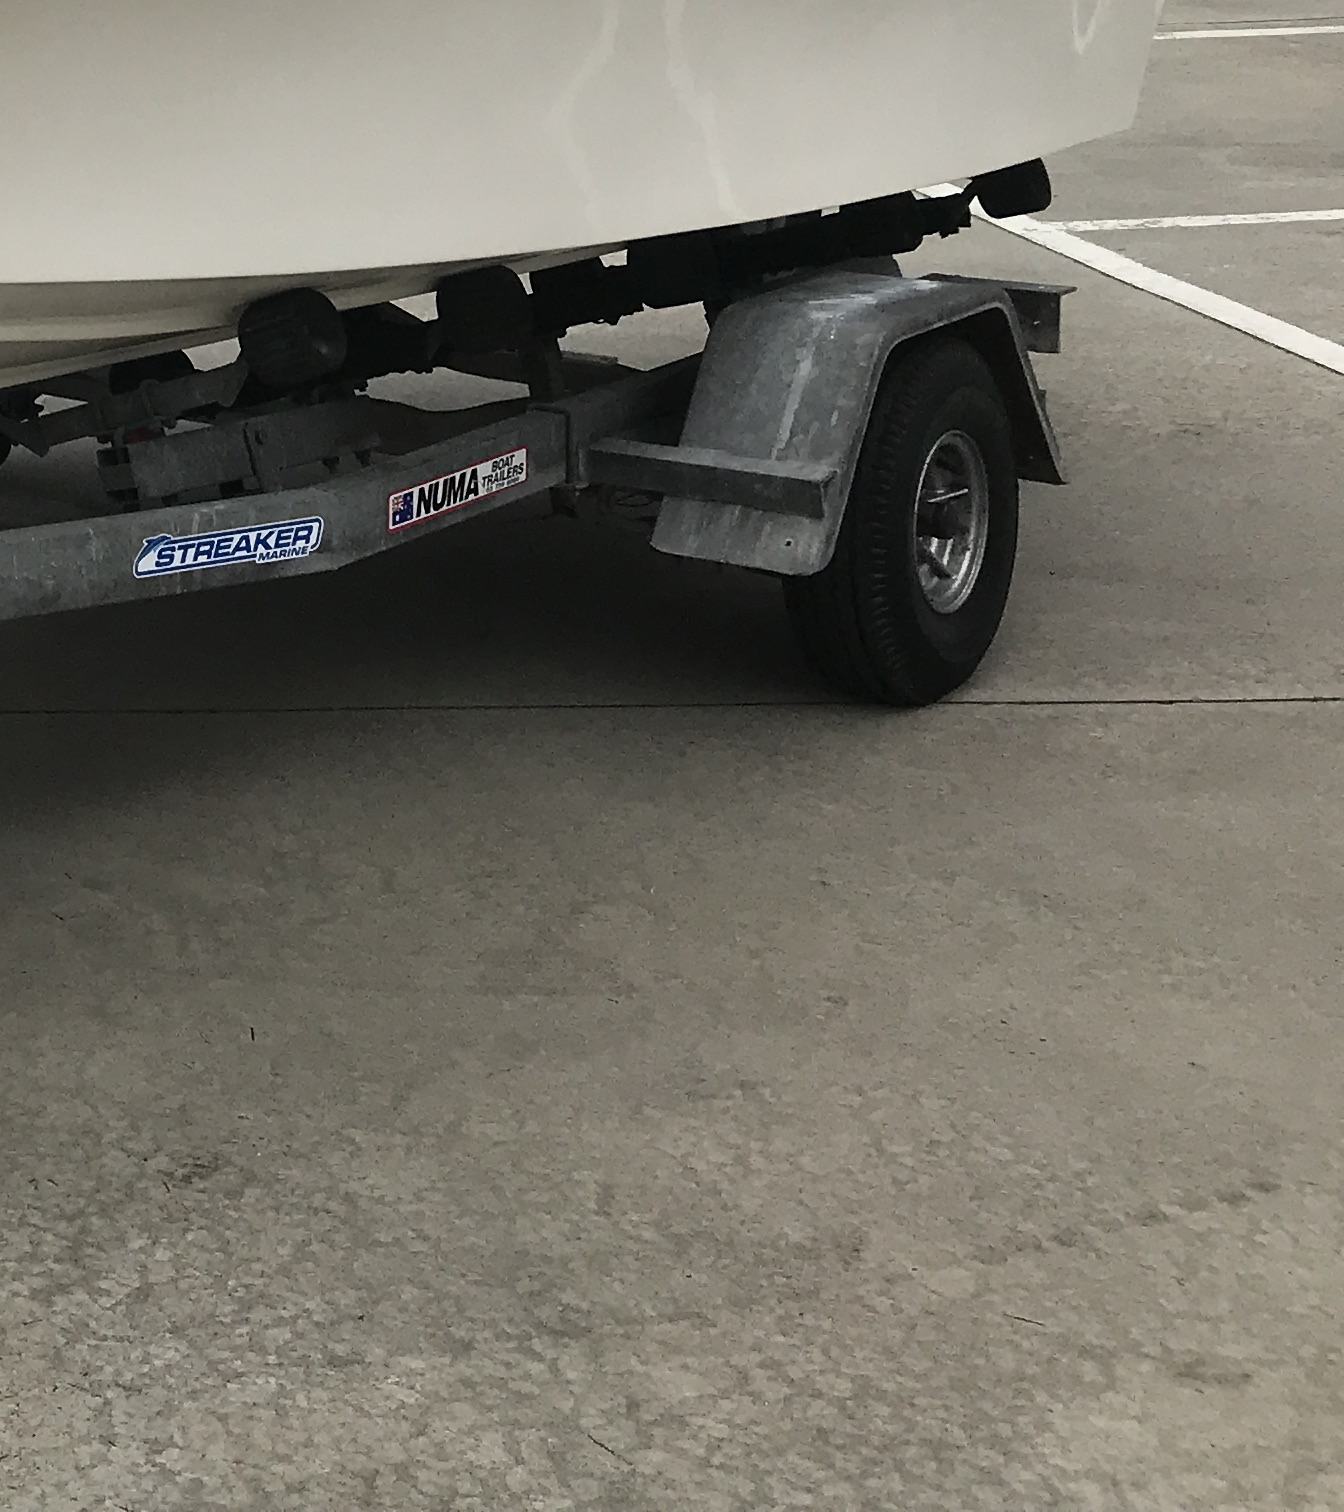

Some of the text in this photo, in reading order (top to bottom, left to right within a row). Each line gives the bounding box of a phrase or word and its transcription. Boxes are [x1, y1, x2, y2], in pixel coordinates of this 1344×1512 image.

[482, 462, 524, 488] TRAILERS
[491, 454, 515, 473] BOAT
[415, 467, 479, 519] NUMA
[155, 524, 314, 568] STREAKER
[257, 545, 309, 562] MARINE
